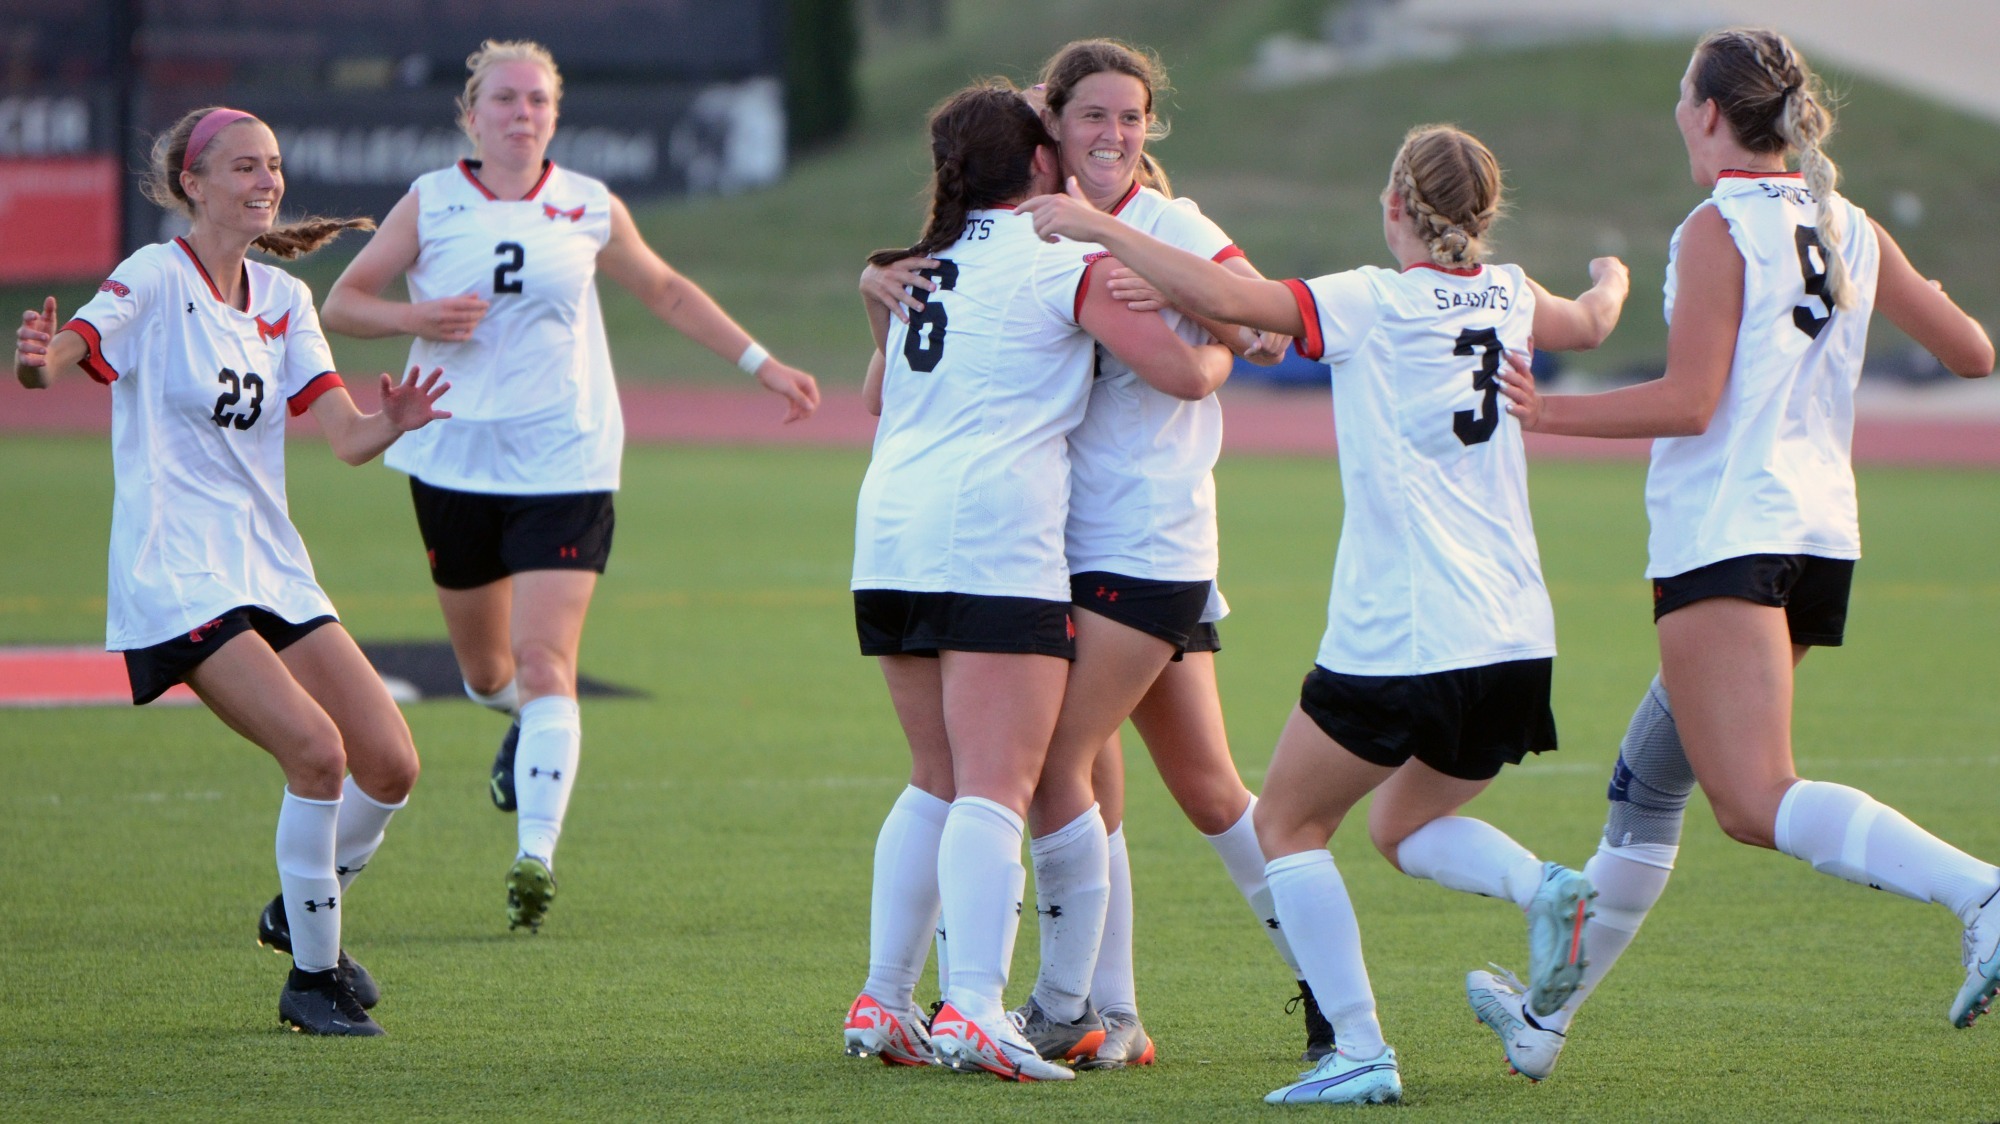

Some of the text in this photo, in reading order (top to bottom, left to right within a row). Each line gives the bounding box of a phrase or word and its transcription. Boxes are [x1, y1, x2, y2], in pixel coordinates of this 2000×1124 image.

[494, 241, 525, 294] 2
[904, 258, 960, 373] 6
[1792, 223, 1835, 340] 9
[211, 367, 264, 431] 23
[1452, 326, 1504, 447] 3
